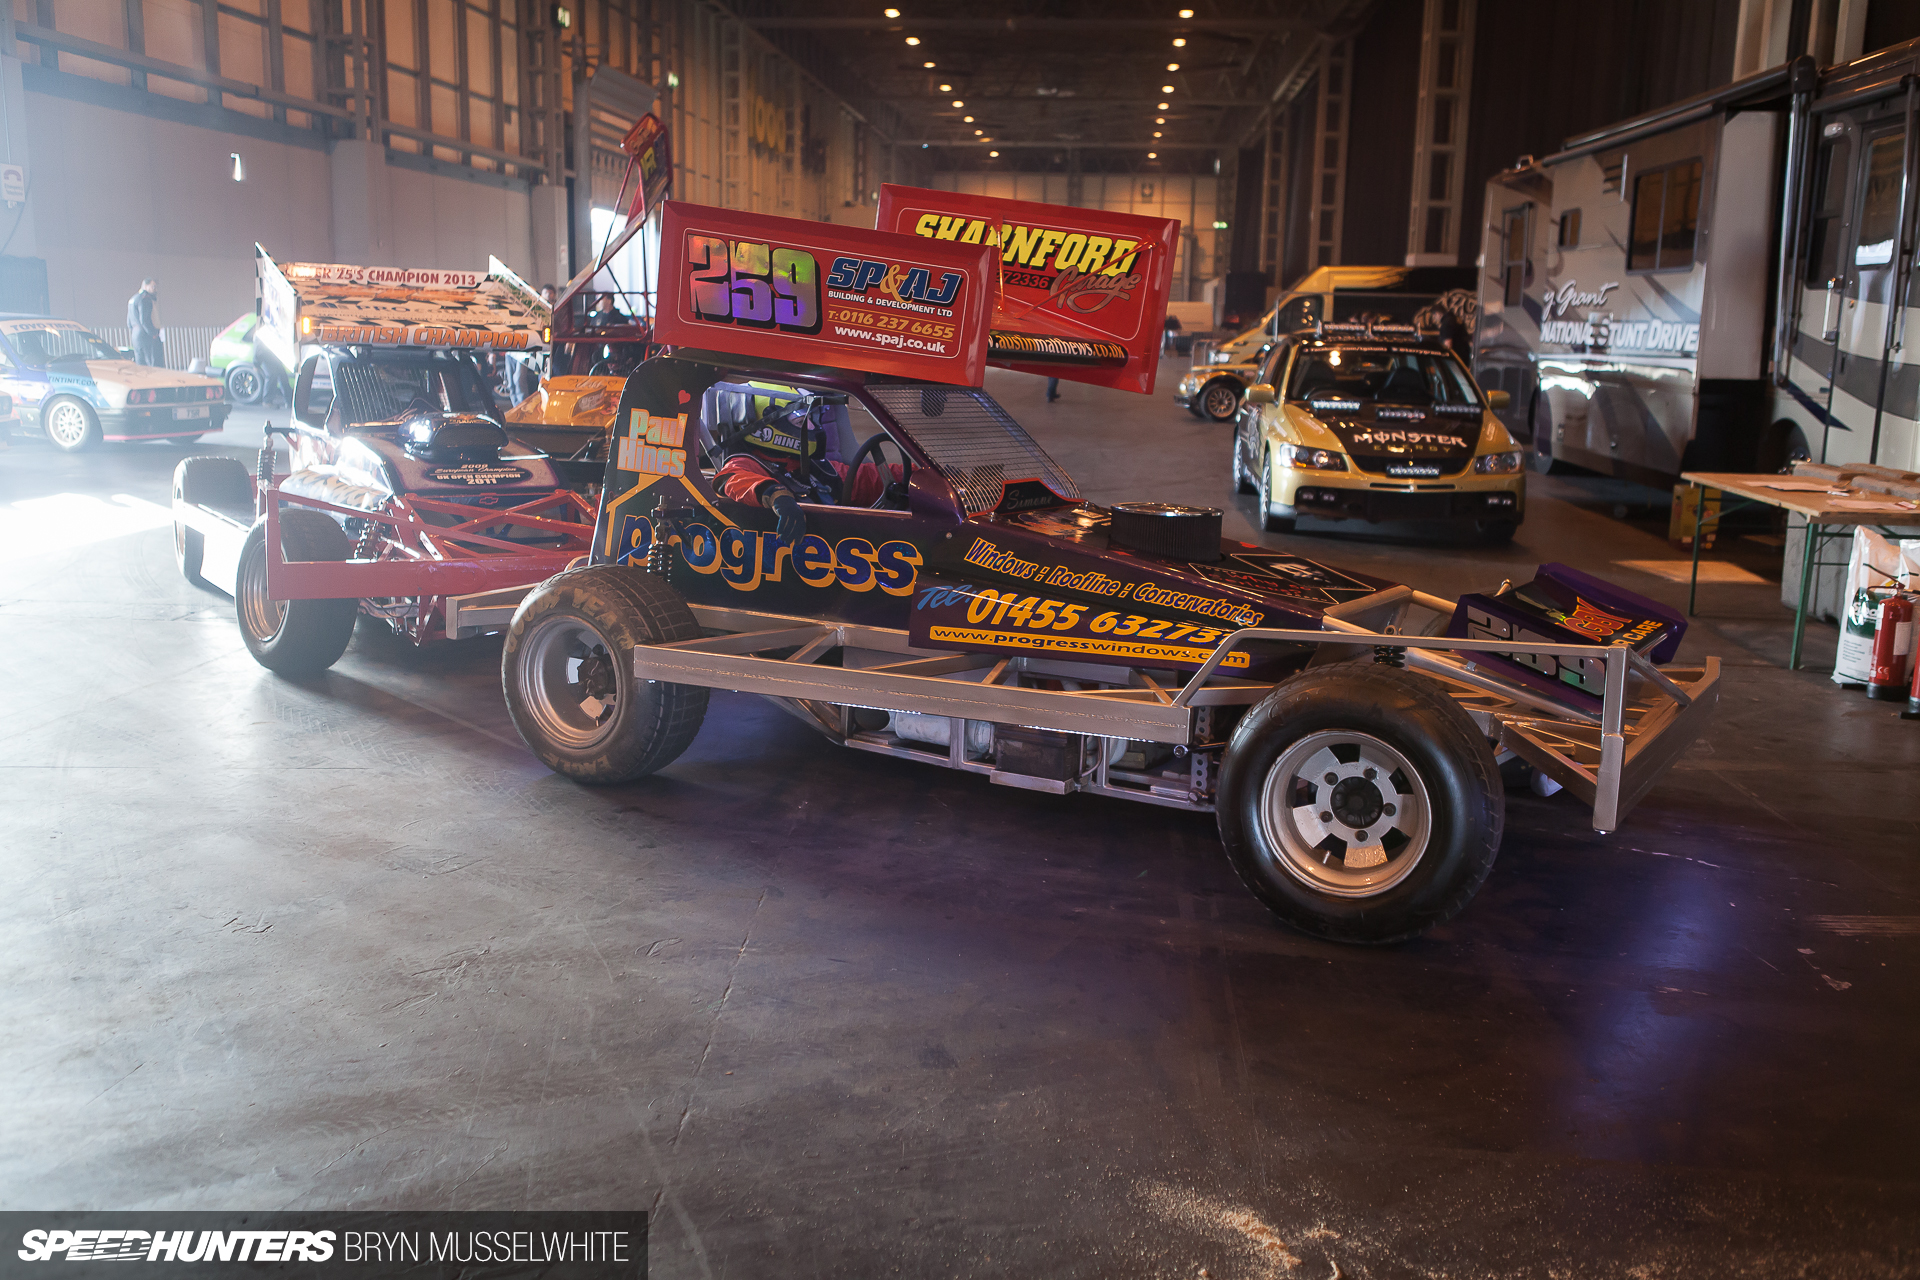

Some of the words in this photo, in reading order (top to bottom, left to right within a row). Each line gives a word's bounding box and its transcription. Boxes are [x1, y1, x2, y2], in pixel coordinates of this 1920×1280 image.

[914, 213, 1140, 278] SHARNFORD
[368, 269, 439, 285] CHAMPION
[444, 273, 476, 286] 2013
[687, 234, 820, 333] 259
[826, 256, 962, 305] SP&AJ
[997, 271, 1050, 288] 72336
[1050, 265, 1142, 314] Garage
[828, 290, 865, 303] BUILDING
[867, 296, 873, 304] &
[875, 298, 935, 314] DEVELOPMENT
[937, 309, 953, 317] LTD
[1556, 279, 1619, 316] Grant
[321, 325, 409, 345] BRITISH
[413, 327, 529, 349] CHAMPION
[834, 326, 946, 353] www.spaj.co.uk
[877, 316, 909, 331] 237
[911, 322, 955, 339] 6655
[629, 408, 688, 448] Paul
[773, 434, 802, 450] HINE
[1353, 430, 1468, 448] MONSTER
[617, 436, 687, 478] Hines
[964, 536, 1040, 580] Windows
[1045, 565, 1121, 596] Roofline
[1133, 582, 1265, 627] Conservatories
[966, 588, 1090, 631] 01455
[1089, 611, 1233, 646] 63273
[1622, 620, 1663, 642] CARE
[933, 628, 1246, 664] www.progresswindows.cm
